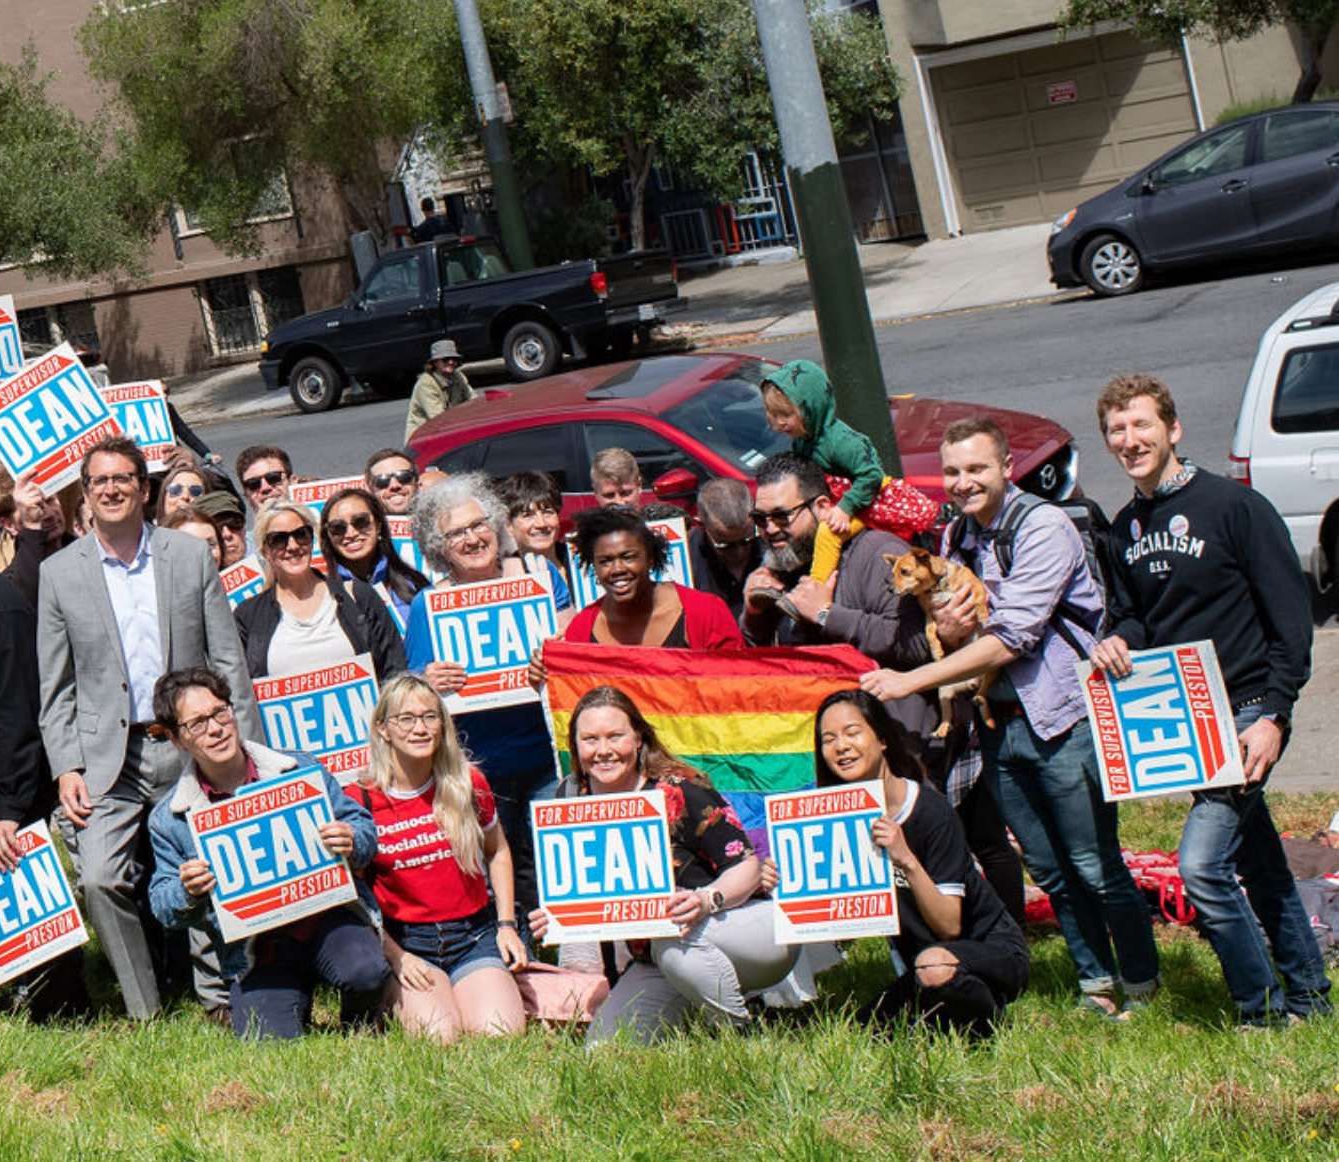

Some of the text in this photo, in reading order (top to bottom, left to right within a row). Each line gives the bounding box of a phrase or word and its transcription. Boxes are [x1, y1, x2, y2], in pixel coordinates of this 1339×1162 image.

[0, 357, 60, 404] SUPERVISOR
[295, 488, 314, 500] FOR
[1125, 531, 1205, 565] SOCIALISM
[434, 581, 534, 610] FOR SUPERVISOR
[438, 602, 551, 668] DEAN
[258, 664, 356, 700] FOR SUPERVISOR
[1179, 652, 1214, 720] PRESTON
[263, 684, 375, 752] DEAN
[1115, 656, 1201, 788] DEAN
[1087, 680, 1129, 793] FOR SUPERVISOR
[327, 748, 369, 772] PREST
[197, 784, 307, 831] FOR SUPERVISOR
[538, 798, 645, 824] FOR SUPERVISOR
[773, 790, 865, 819] FOR SUPERVISOR
[207, 804, 337, 893] DEAN
[392, 848, 451, 870] Americ
[543, 823, 665, 896] DEAN
[777, 818, 885, 893] DEAN
[280, 869, 341, 903] PRESTON
[602, 900, 667, 922] PRESTON
[830, 896, 887, 920] PRESTON
[25, 913, 75, 949] PRESTON
